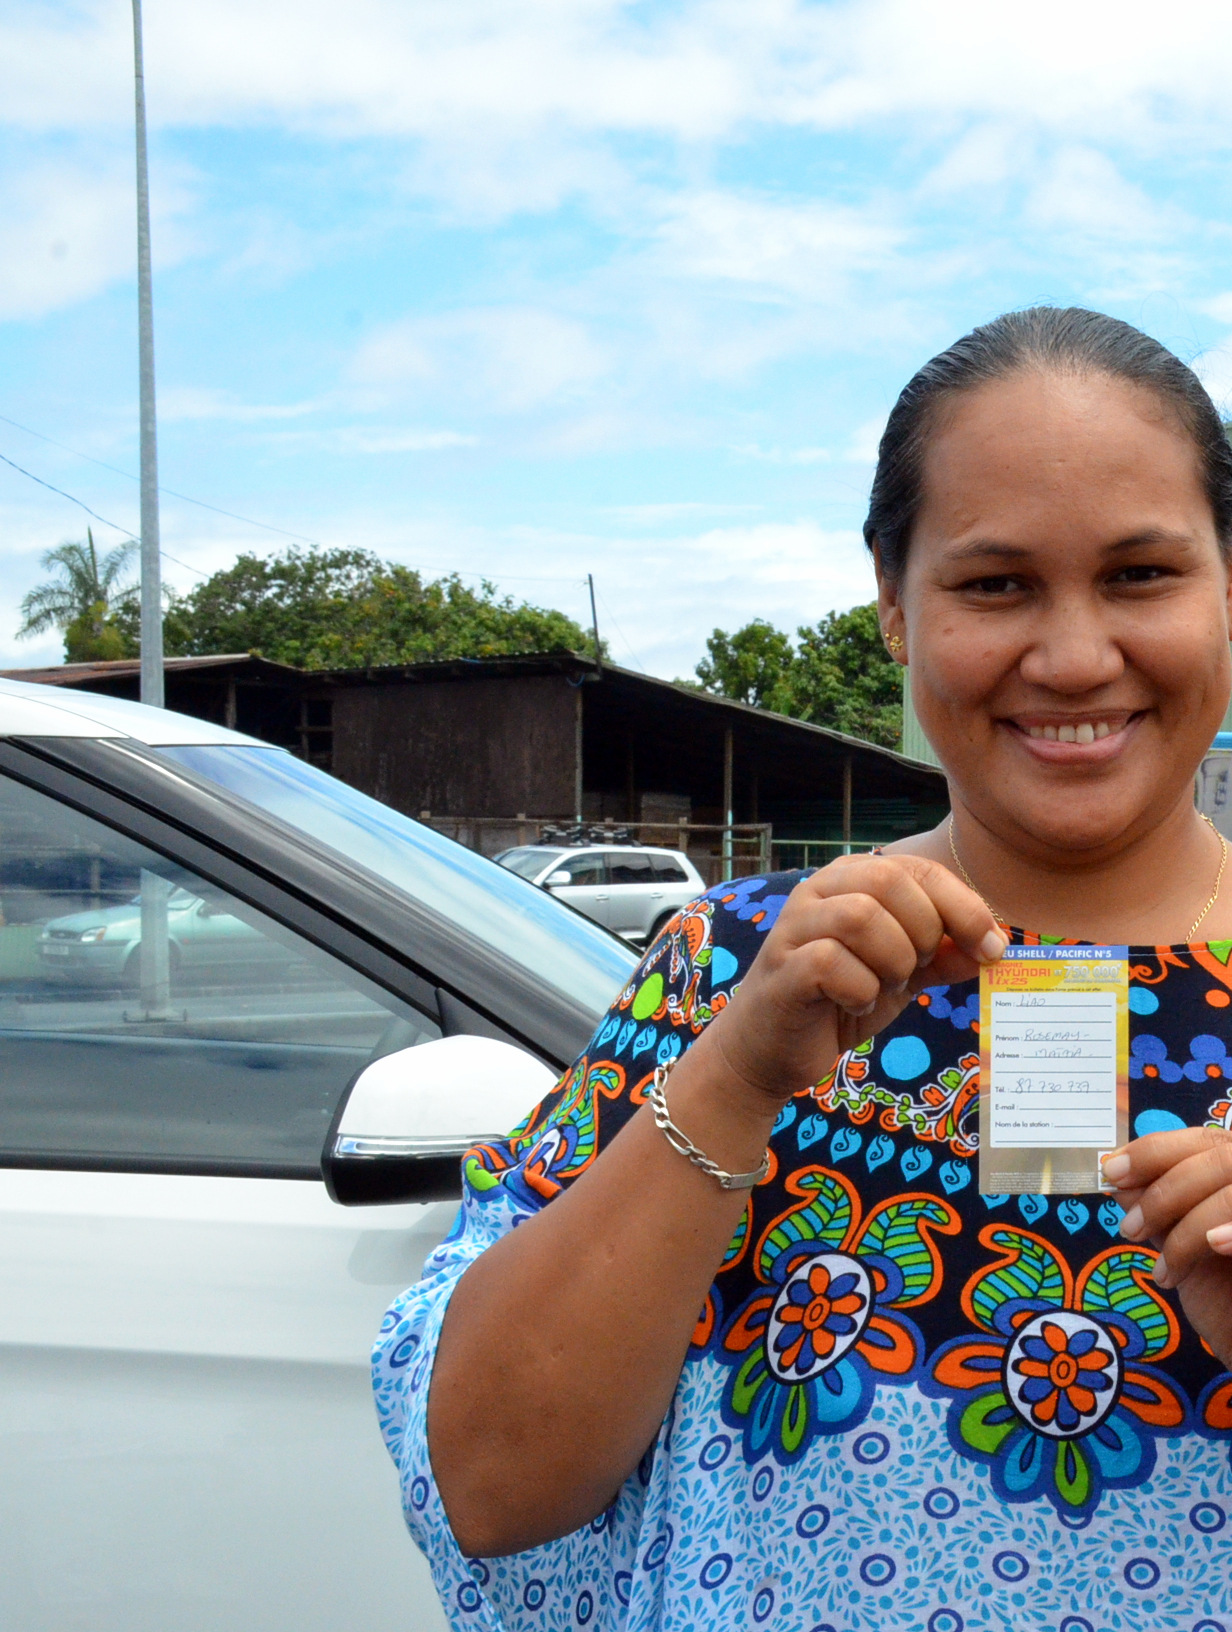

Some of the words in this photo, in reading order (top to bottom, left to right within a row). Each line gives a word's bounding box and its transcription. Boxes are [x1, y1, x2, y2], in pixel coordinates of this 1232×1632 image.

[1002, 950, 1014, 959] EU
[1017, 950, 1046, 959] SHELL
[1056, 950, 1092, 959] PACIFIC
[985, 968, 994, 985] 1
[996, 968, 1050, 977] HYUNDAI
[1063, 966, 1089, 978] 750
